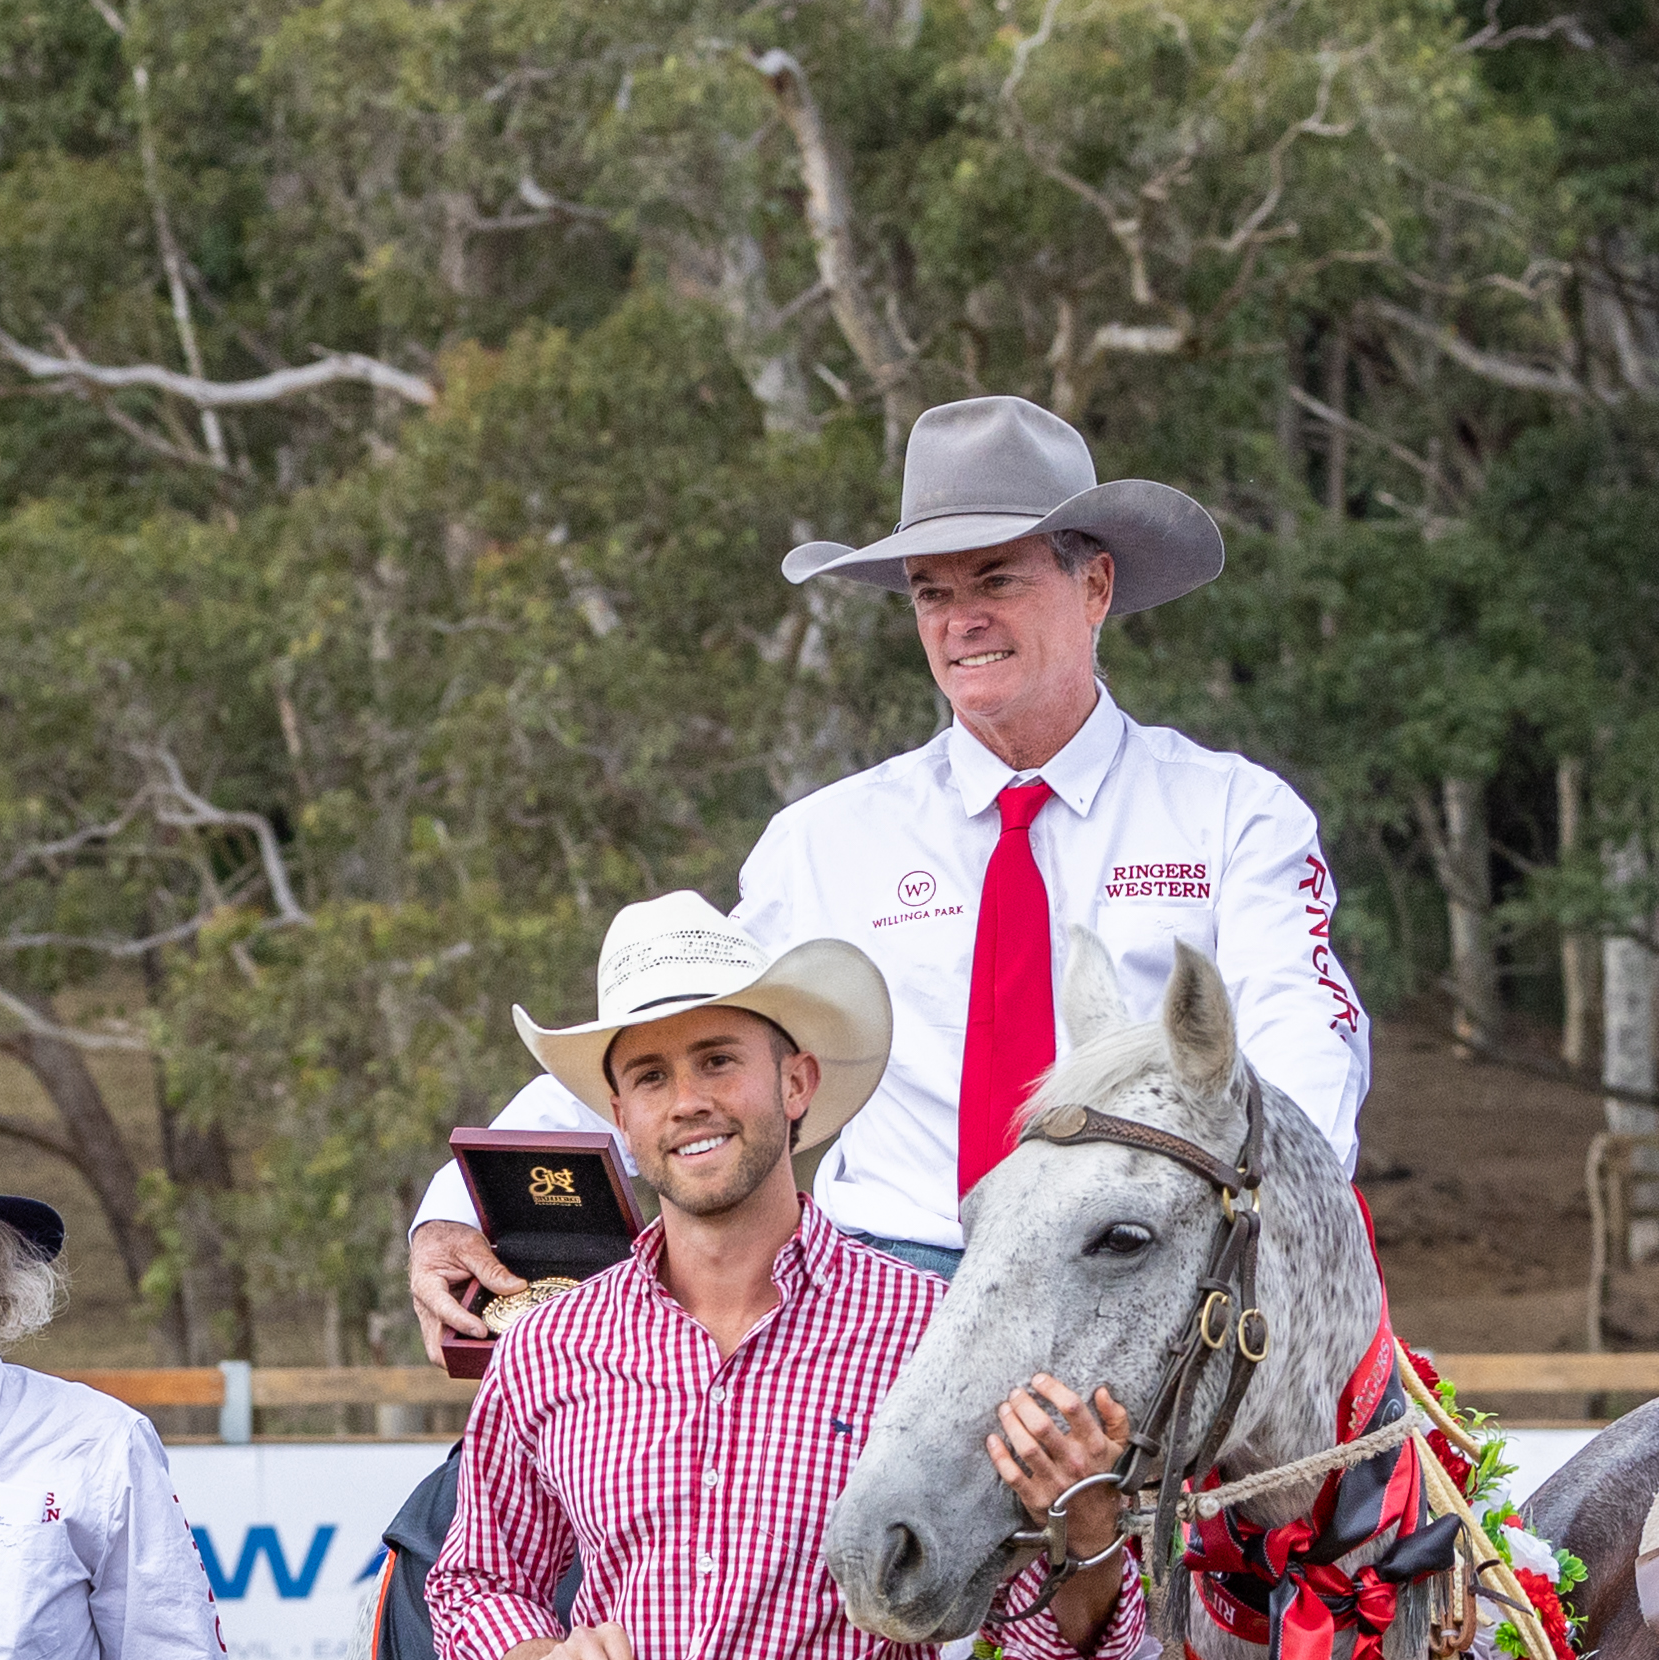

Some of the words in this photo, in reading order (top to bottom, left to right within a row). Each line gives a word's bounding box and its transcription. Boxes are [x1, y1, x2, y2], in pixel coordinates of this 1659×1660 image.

[1113, 863, 1206, 881] RINGERS
[1105, 881, 1211, 899] WESTERN
[872, 910, 930, 929] WILLINGA
[934, 905, 964, 917] PARK
